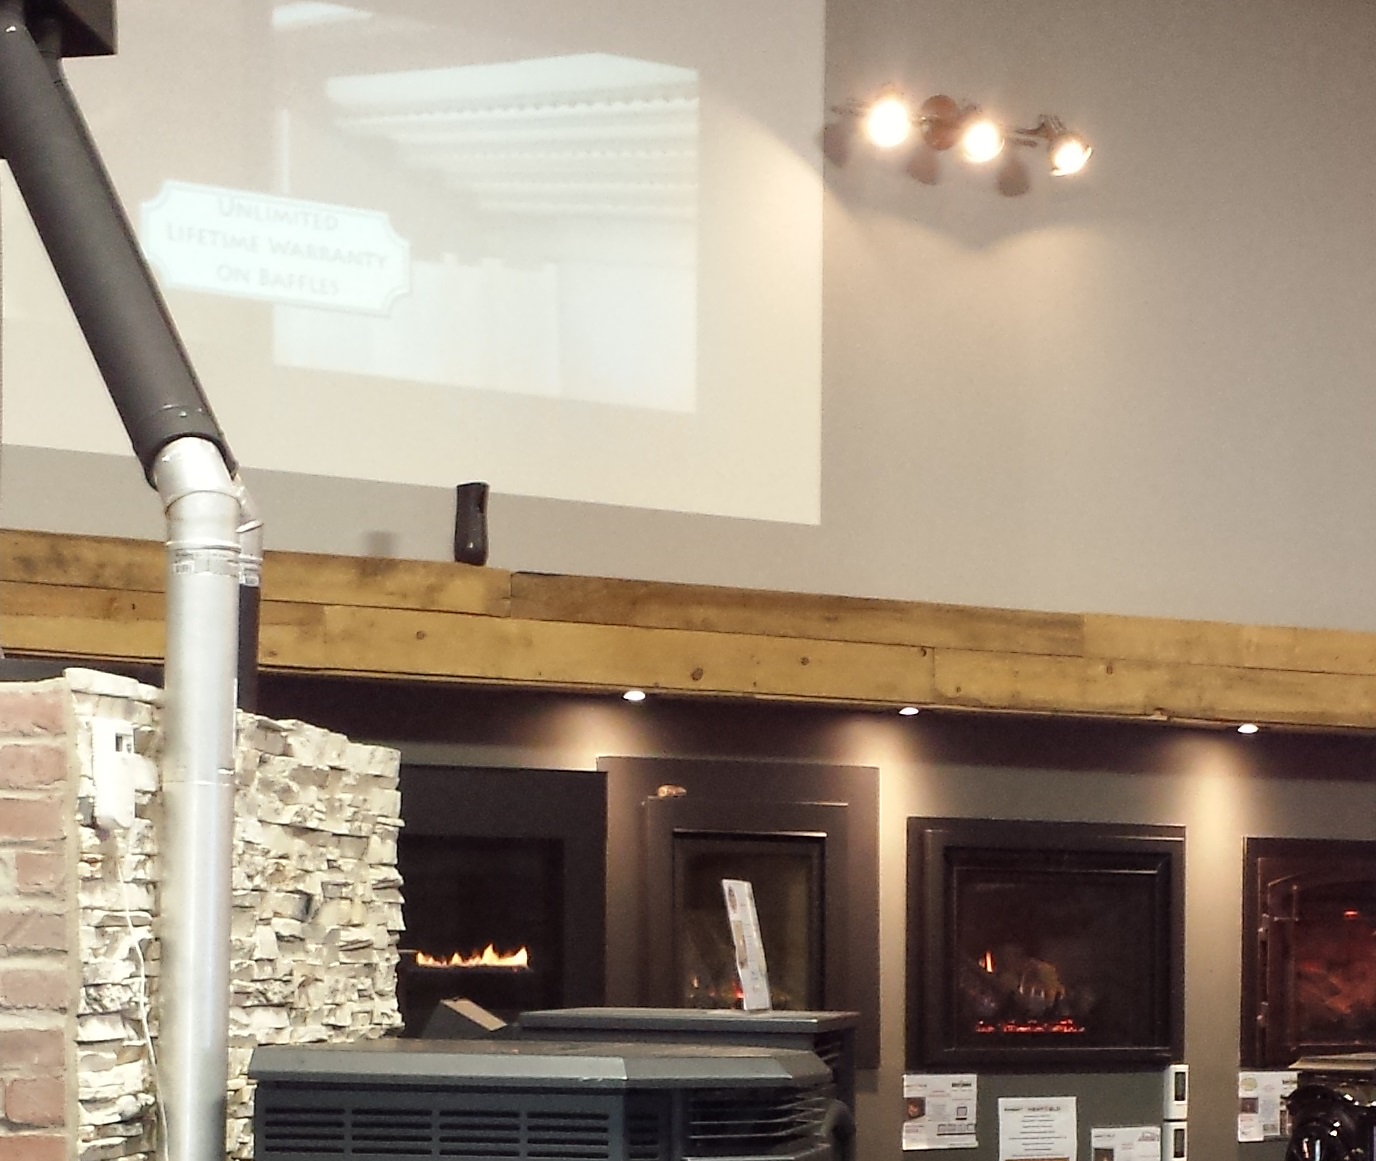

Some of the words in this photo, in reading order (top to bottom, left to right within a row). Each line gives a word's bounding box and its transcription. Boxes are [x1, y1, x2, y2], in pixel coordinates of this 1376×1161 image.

[216, 196, 341, 233] UNLIMITED
[167, 221, 260, 254] LIFETIME
[267, 235, 387, 269] WARRANTY
[216, 263, 250, 284] ON
[259, 267, 341, 297] BAFFLES
